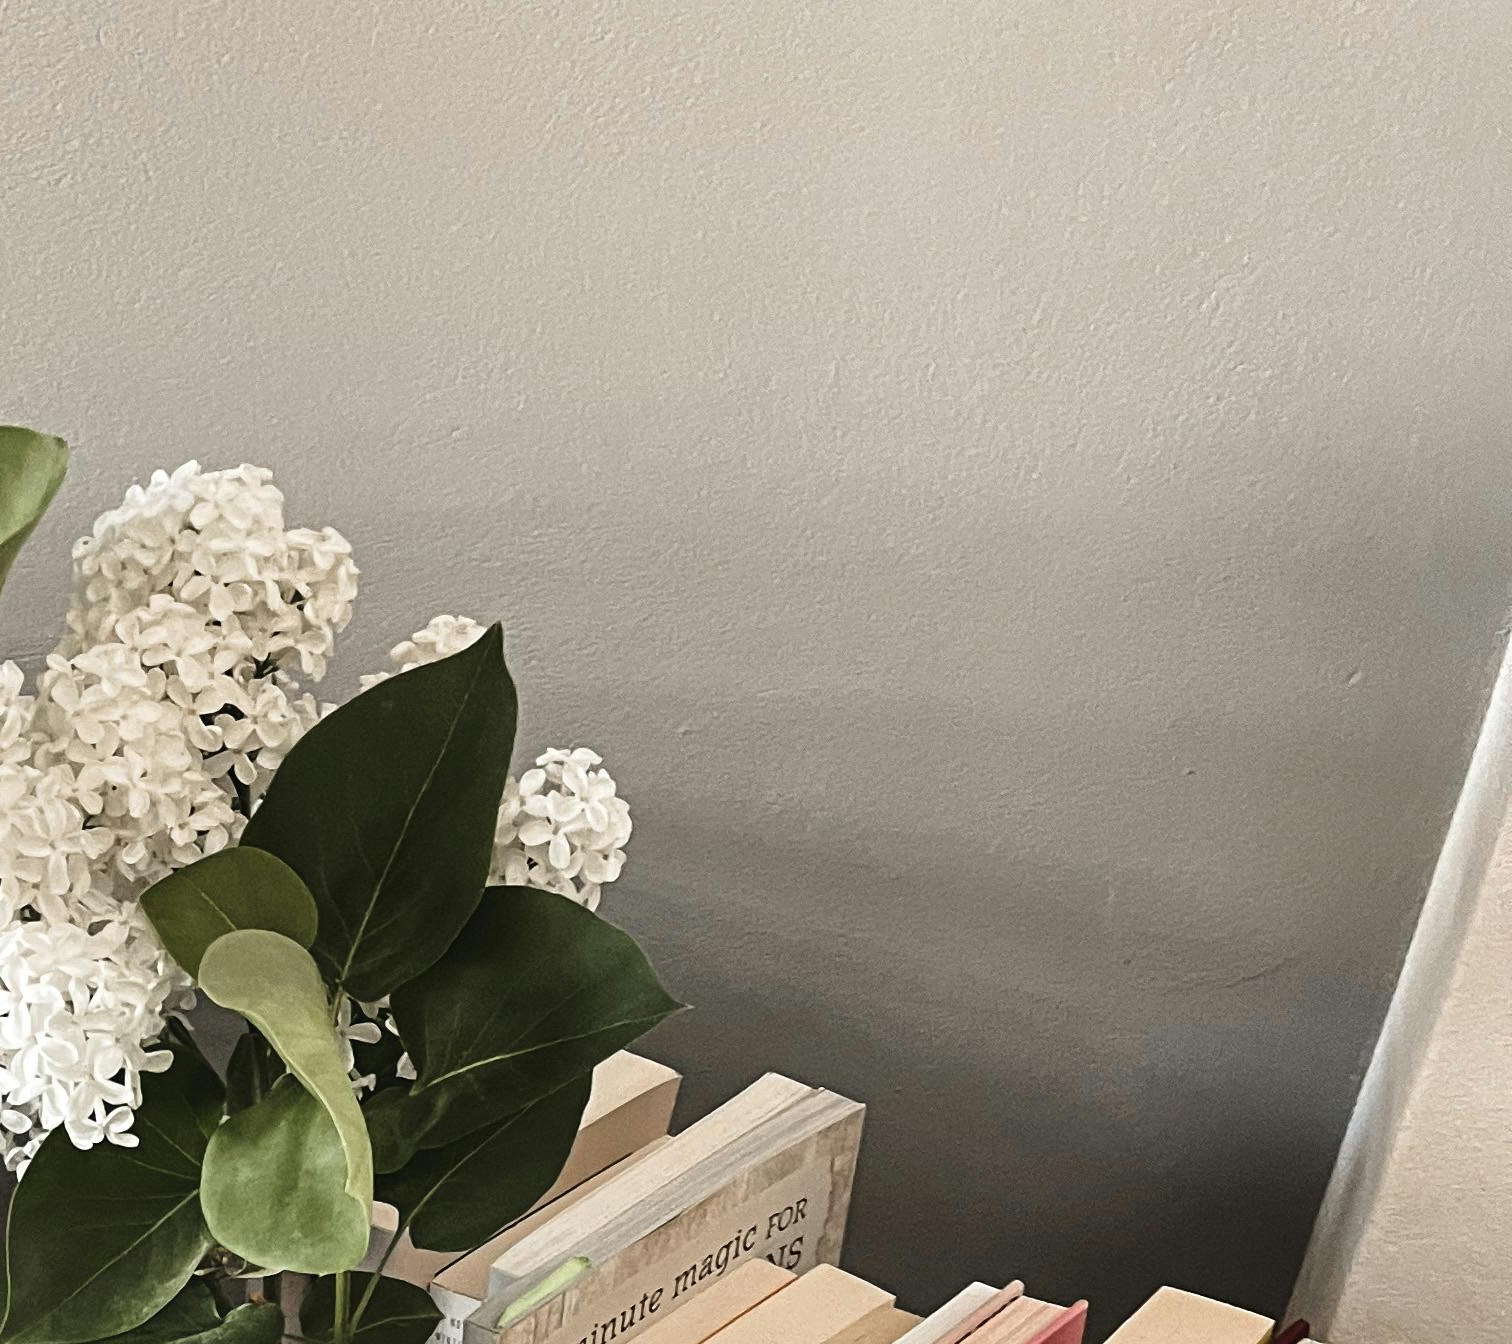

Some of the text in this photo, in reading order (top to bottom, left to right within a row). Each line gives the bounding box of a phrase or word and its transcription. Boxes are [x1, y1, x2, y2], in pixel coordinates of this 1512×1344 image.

[671, 1224, 758, 1299] magic
[765, 1197, 808, 1241] FOR
[765, 1236, 804, 1272] NS
